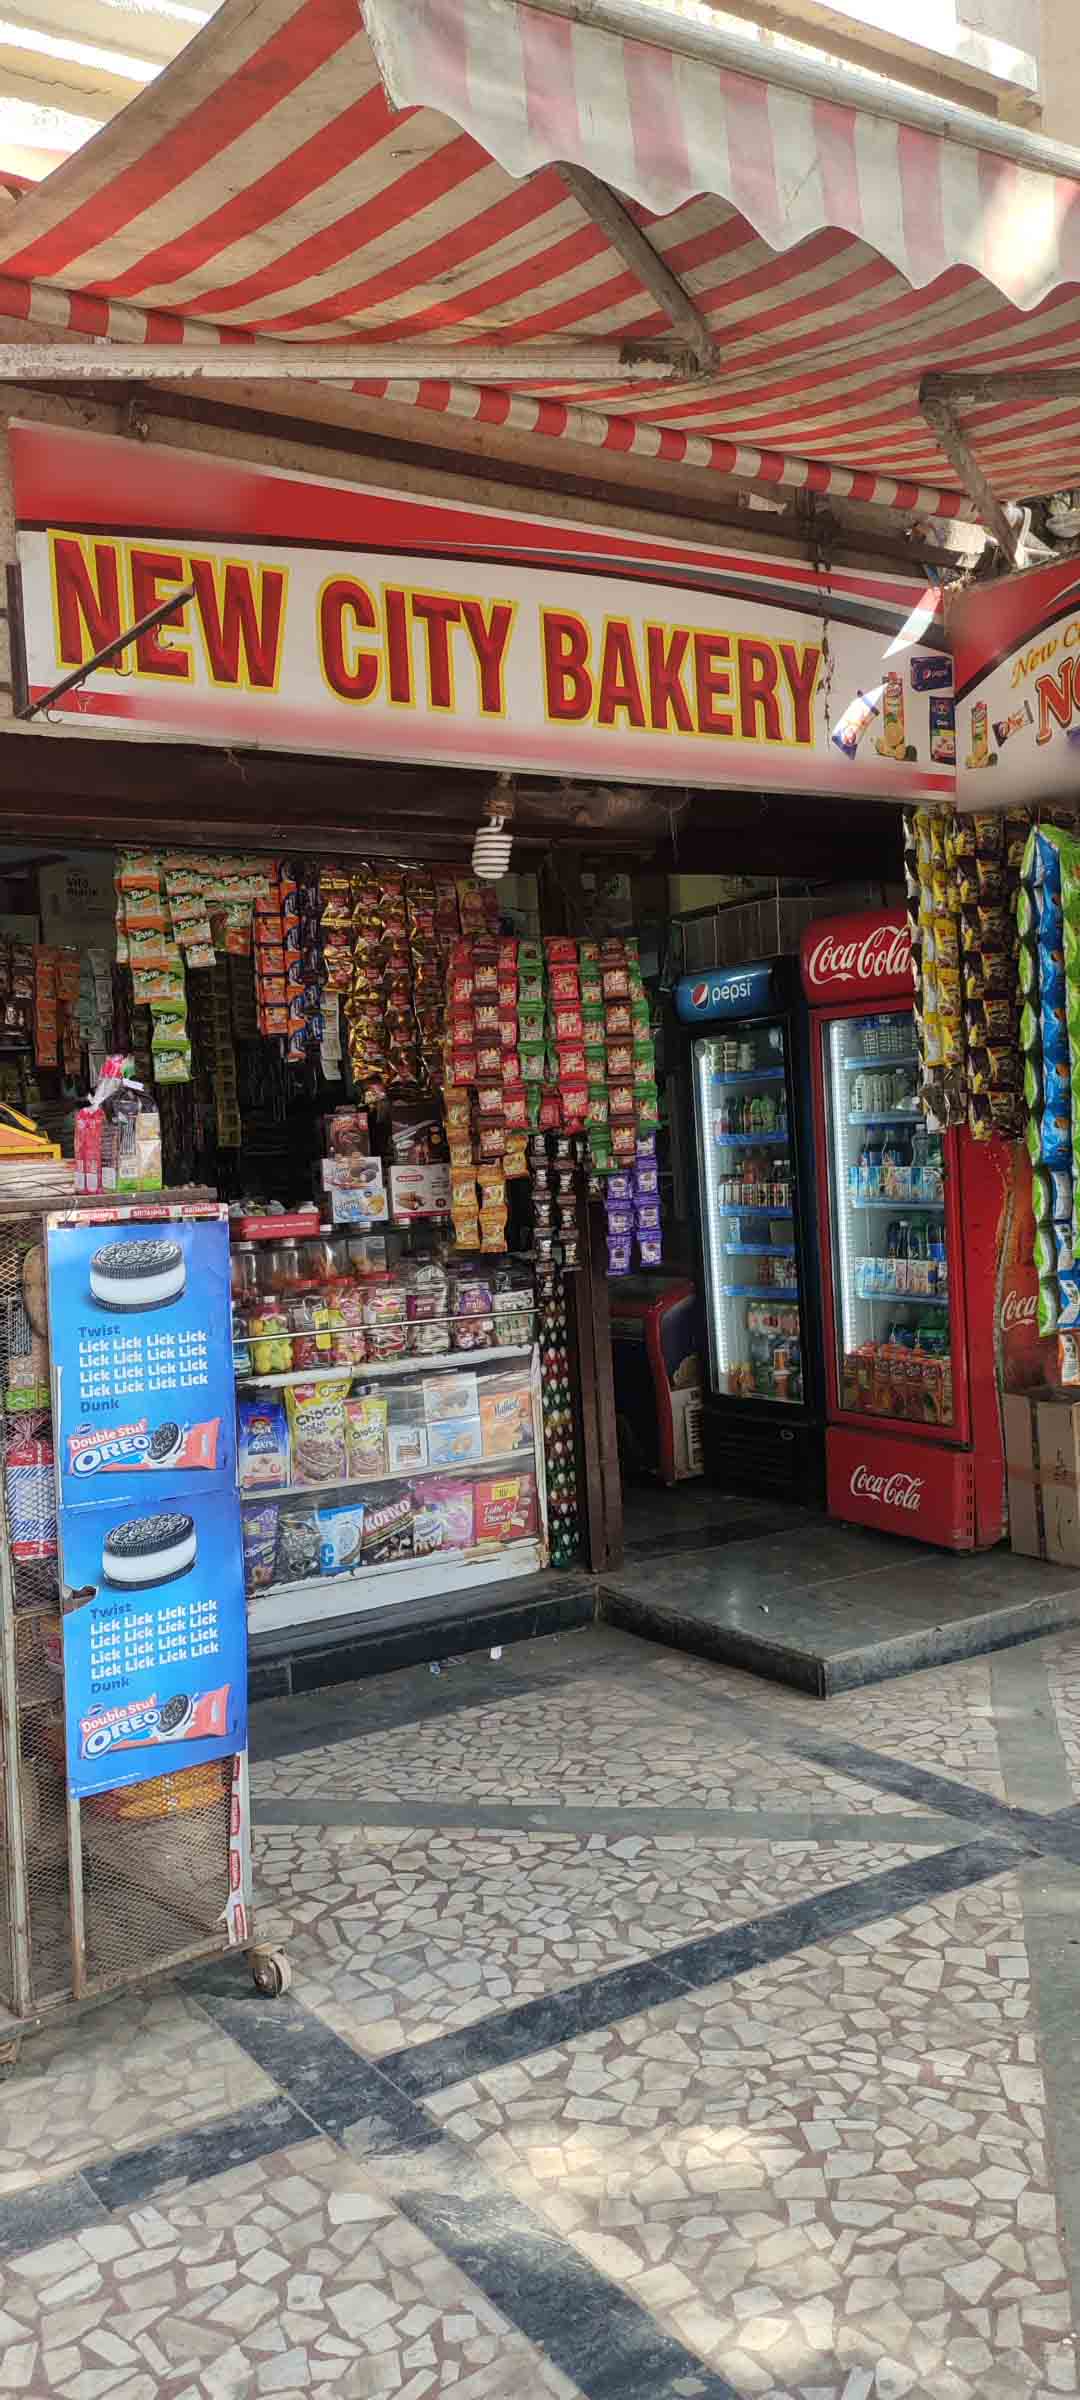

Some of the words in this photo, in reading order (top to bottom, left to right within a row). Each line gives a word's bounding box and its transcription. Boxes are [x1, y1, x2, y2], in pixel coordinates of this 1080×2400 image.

[48, 529, 288, 693] NEW
[319, 574, 518, 719] CITY
[540, 605, 823, 747] BAKERY
[809, 925, 913, 985] Coca-Cola
[711, 979, 751, 1005] pepsi
[79, 1324, 120, 1338] Twist
[79, 1339, 110, 1354] Lick
[113, 1335, 142, 1350] Lick
[147, 1332, 175, 1348] Lick
[178, 1330, 208, 1345] Lick
[80, 1353, 110, 1369] Lick
[113, 1350, 143, 1365] Lick
[147, 1346, 175, 1362] Lick
[179, 1344, 208, 1359] Lick
[80, 1367, 111, 1383] Lick
[114, 1364, 143, 1379] Lick
[148, 1361, 176, 1376] Lick
[179, 1358, 208, 1373] Lick
[80, 1382, 111, 1399] Lick
[114, 1379, 144, 1395] Lick
[148, 1375, 177, 1391] Lick
[180, 1372, 208, 1388] Lick
[80, 1398, 119, 1413] Dunk
[71, 1430, 118, 1450] Double
[73, 1435, 149, 1474] OREO
[850, 1464, 924, 1511] Coca-Cola
[90, 1602, 133, 1620] Twist
[90, 1619, 120, 1635] Lick
[124, 1614, 153, 1630] Lick
[157, 1607, 186, 1622] Lick
[189, 1600, 217, 1614] Lick
[90, 1633, 120, 1650] Lick
[124, 1628, 153, 1643] Lick
[157, 1621, 185, 1636] Lick
[189, 1614, 217, 1628] Lick
[91, 1648, 121, 1665] Lick
[125, 1642, 153, 1657] Lick
[158, 1634, 186, 1649] Lick
[190, 1628, 218, 1642] Lick
[91, 1663, 122, 1680] Lick
[125, 1656, 154, 1672] Lick
[159, 1648, 188, 1665] Lick
[191, 1642, 219, 1657] Lick
[91, 1676, 129, 1694] Dunk
[81, 1707, 127, 1732] Double
[86, 1711, 159, 1754] OREO
